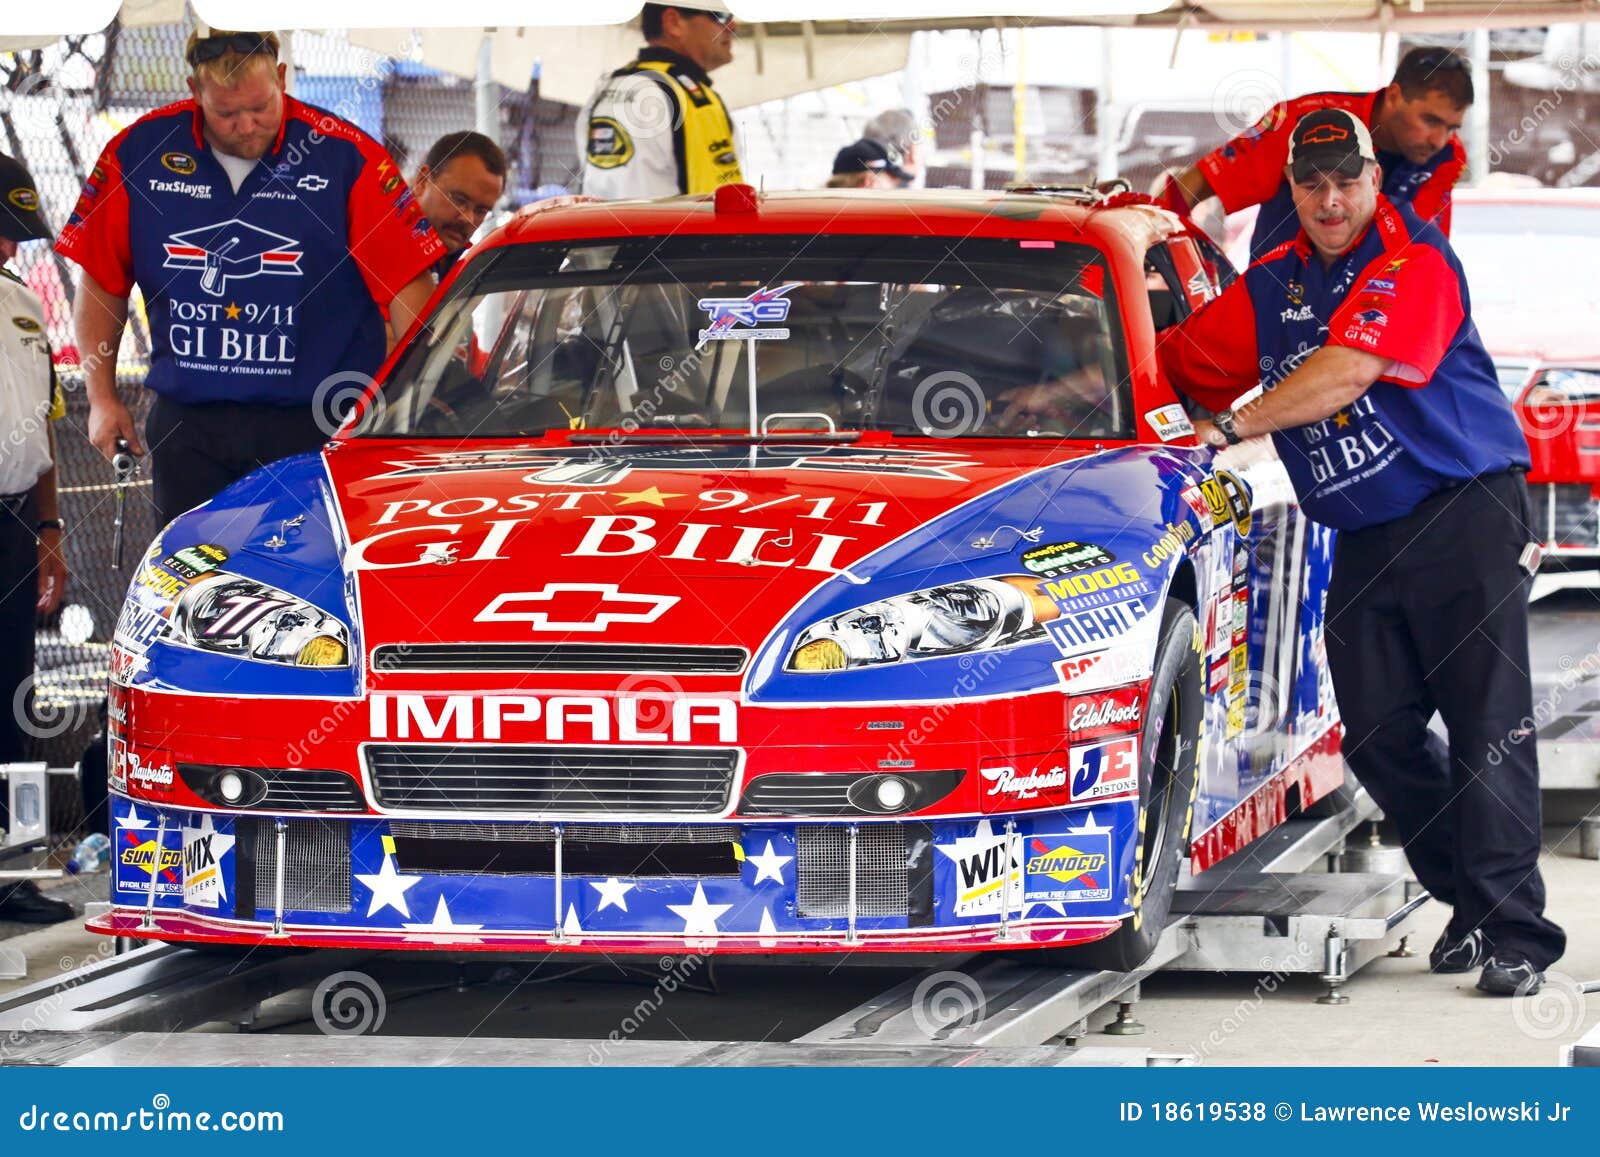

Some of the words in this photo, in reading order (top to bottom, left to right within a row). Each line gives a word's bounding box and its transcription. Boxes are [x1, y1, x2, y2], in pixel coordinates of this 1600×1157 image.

[149, 179, 212, 197] TaxSlayer
[169, 298, 223, 321] POST
[244, 303, 294, 326] 9/11
[698, 298, 791, 328] TRG
[169, 323, 207, 358] GI
[220, 327, 296, 363] BILL
[1344, 329, 1359, 341] GI
[179, 361, 218, 372] DEPARTMENT
[231, 366, 264, 376] VETERANS
[265, 367, 292, 376] AFFAIRS
[1309, 446, 1337, 483] GI
[370, 490, 607, 526] POST
[697, 489, 889, 527] 9/11
[347, 519, 531, 570] GI
[561, 515, 872, 584] BILL
[164, 557, 197, 578] BELTS
[1043, 557, 1111, 578] BELTS
[1045, 562, 1140, 602] MOOG
[1046, 600, 1146, 649] MAHLE
[370, 694, 737, 742] IMPALA
[1069, 696, 1140, 732] Edelbrock
[980, 766, 1068, 796] Raybestos
[1072, 740, 1134, 798] JE
[1092, 779, 1137, 796] PISTONS
[123, 850, 181, 865] SUNCO
[184, 833, 221, 877] WIX
[959, 837, 1018, 889] WIX
[1029, 855, 1102, 873] SUNOCO
[961, 882, 1019, 913] FILTES
